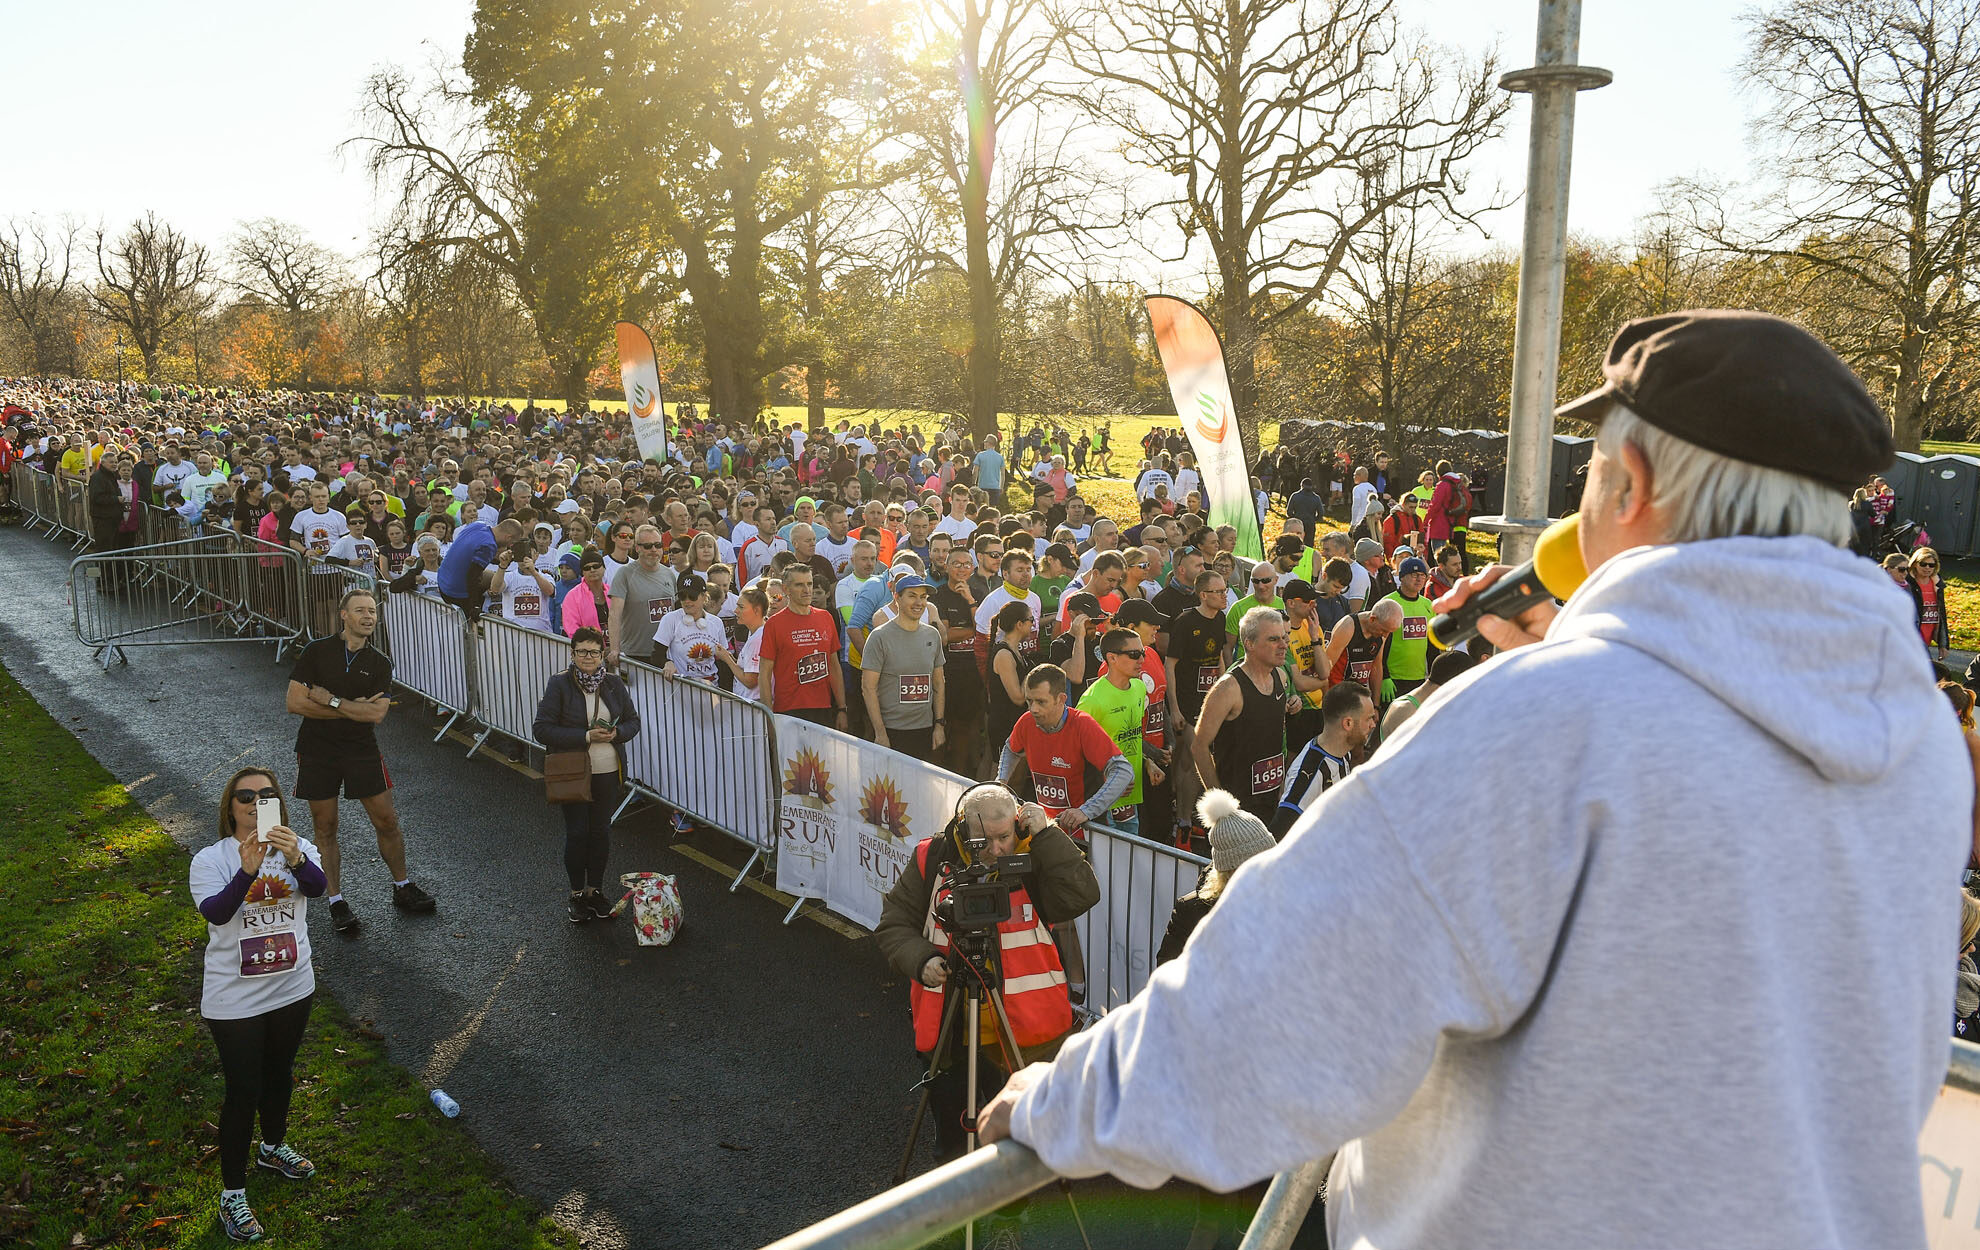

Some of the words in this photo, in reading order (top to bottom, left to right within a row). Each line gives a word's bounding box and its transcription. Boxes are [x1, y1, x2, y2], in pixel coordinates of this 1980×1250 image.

[514, 602, 540, 611] 2692
[1403, 624, 1427, 633] 4369
[686, 664, 713, 673] RUN
[800, 661, 826, 676] 2236
[901, 684, 929, 695] 3259
[1254, 765, 1283, 785] 1655
[1036, 784, 1066, 800] 4699
[778, 817, 836, 854] RUN
[859, 844, 902, 885] RUN
[242, 902, 296, 917] REMEMBRANCE
[242, 908, 295, 929] RUN
